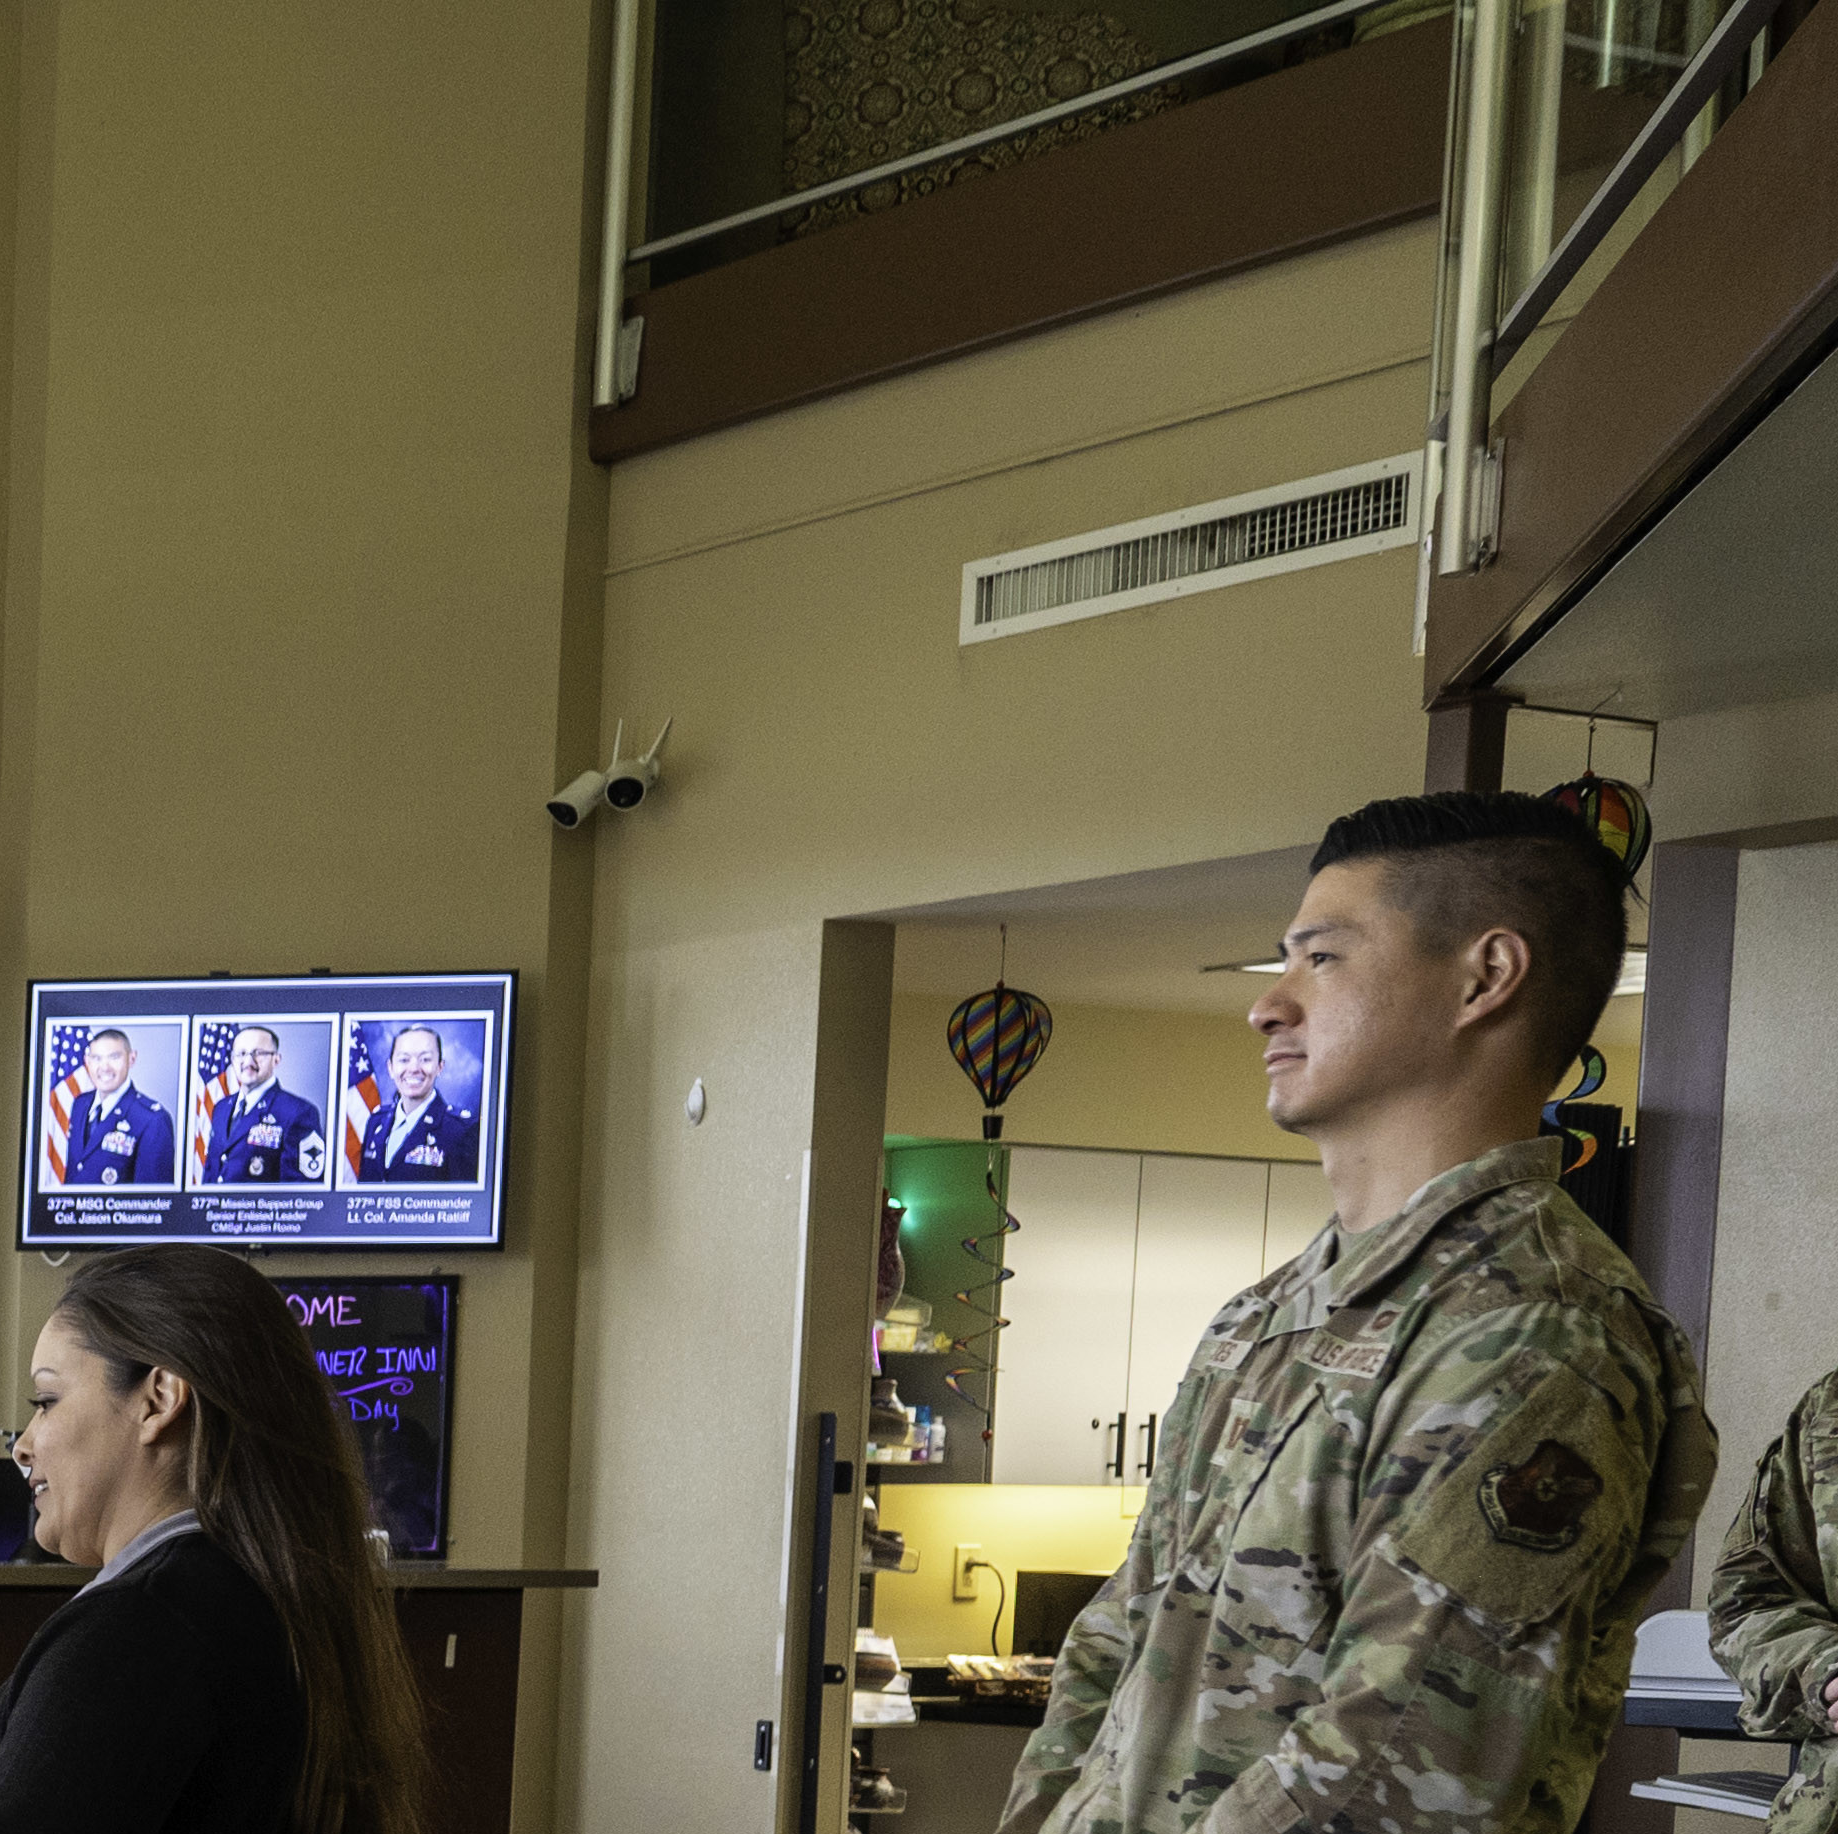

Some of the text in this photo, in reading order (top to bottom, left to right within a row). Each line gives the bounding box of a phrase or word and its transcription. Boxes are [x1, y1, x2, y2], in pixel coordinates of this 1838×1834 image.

[105, 1197, 172, 1210] Commander
[257, 1198, 293, 1211] Support
[294, 1198, 324, 1211] Group
[403, 1196, 472, 1209] Commander
[78, 1211, 110, 1224] Jason
[275, 1211, 307, 1221] Leader
[388, 1211, 435, 1223] Amanda
